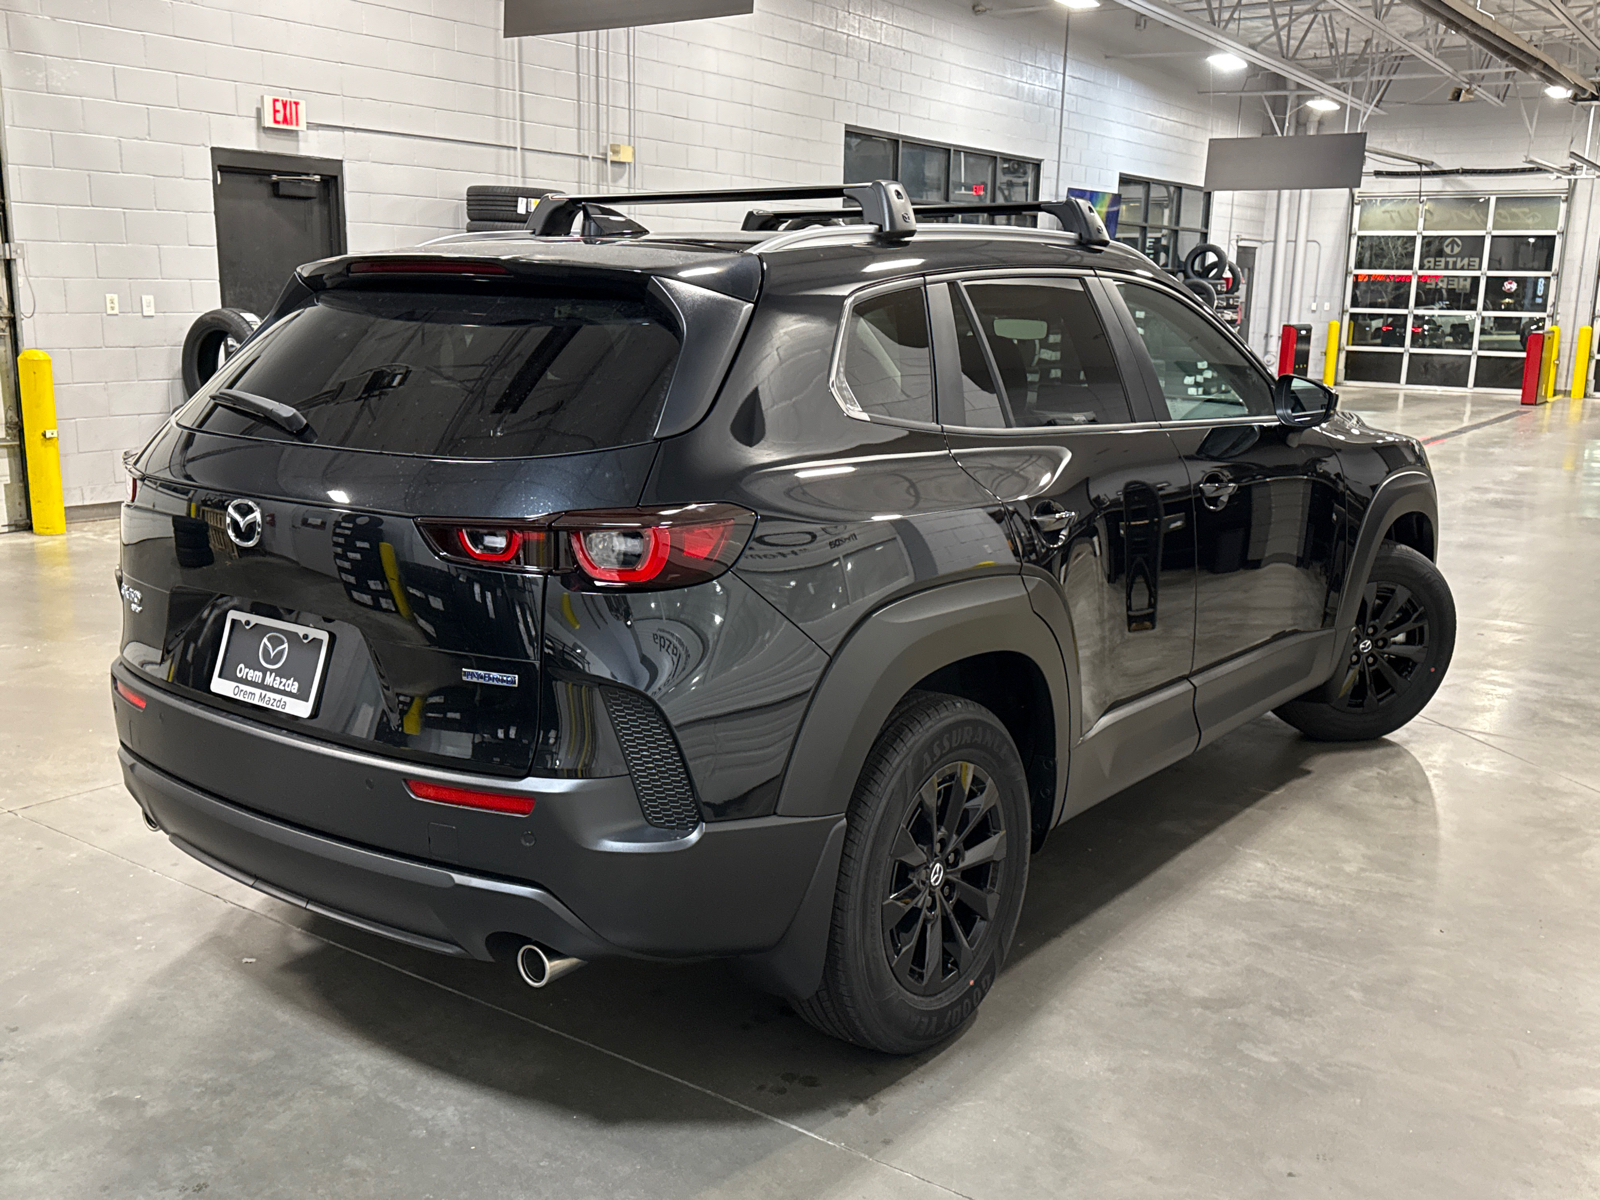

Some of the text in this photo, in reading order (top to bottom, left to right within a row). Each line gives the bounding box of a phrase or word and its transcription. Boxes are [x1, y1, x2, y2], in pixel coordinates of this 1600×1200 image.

[272, 98, 300, 127] EXIT
[236, 663, 299, 694] Orem Mazda
[465, 671, 516, 685] HYBRID
[232, 685, 287, 710] Orem Mazda
[923, 726, 1009, 771] ASSURANCE
